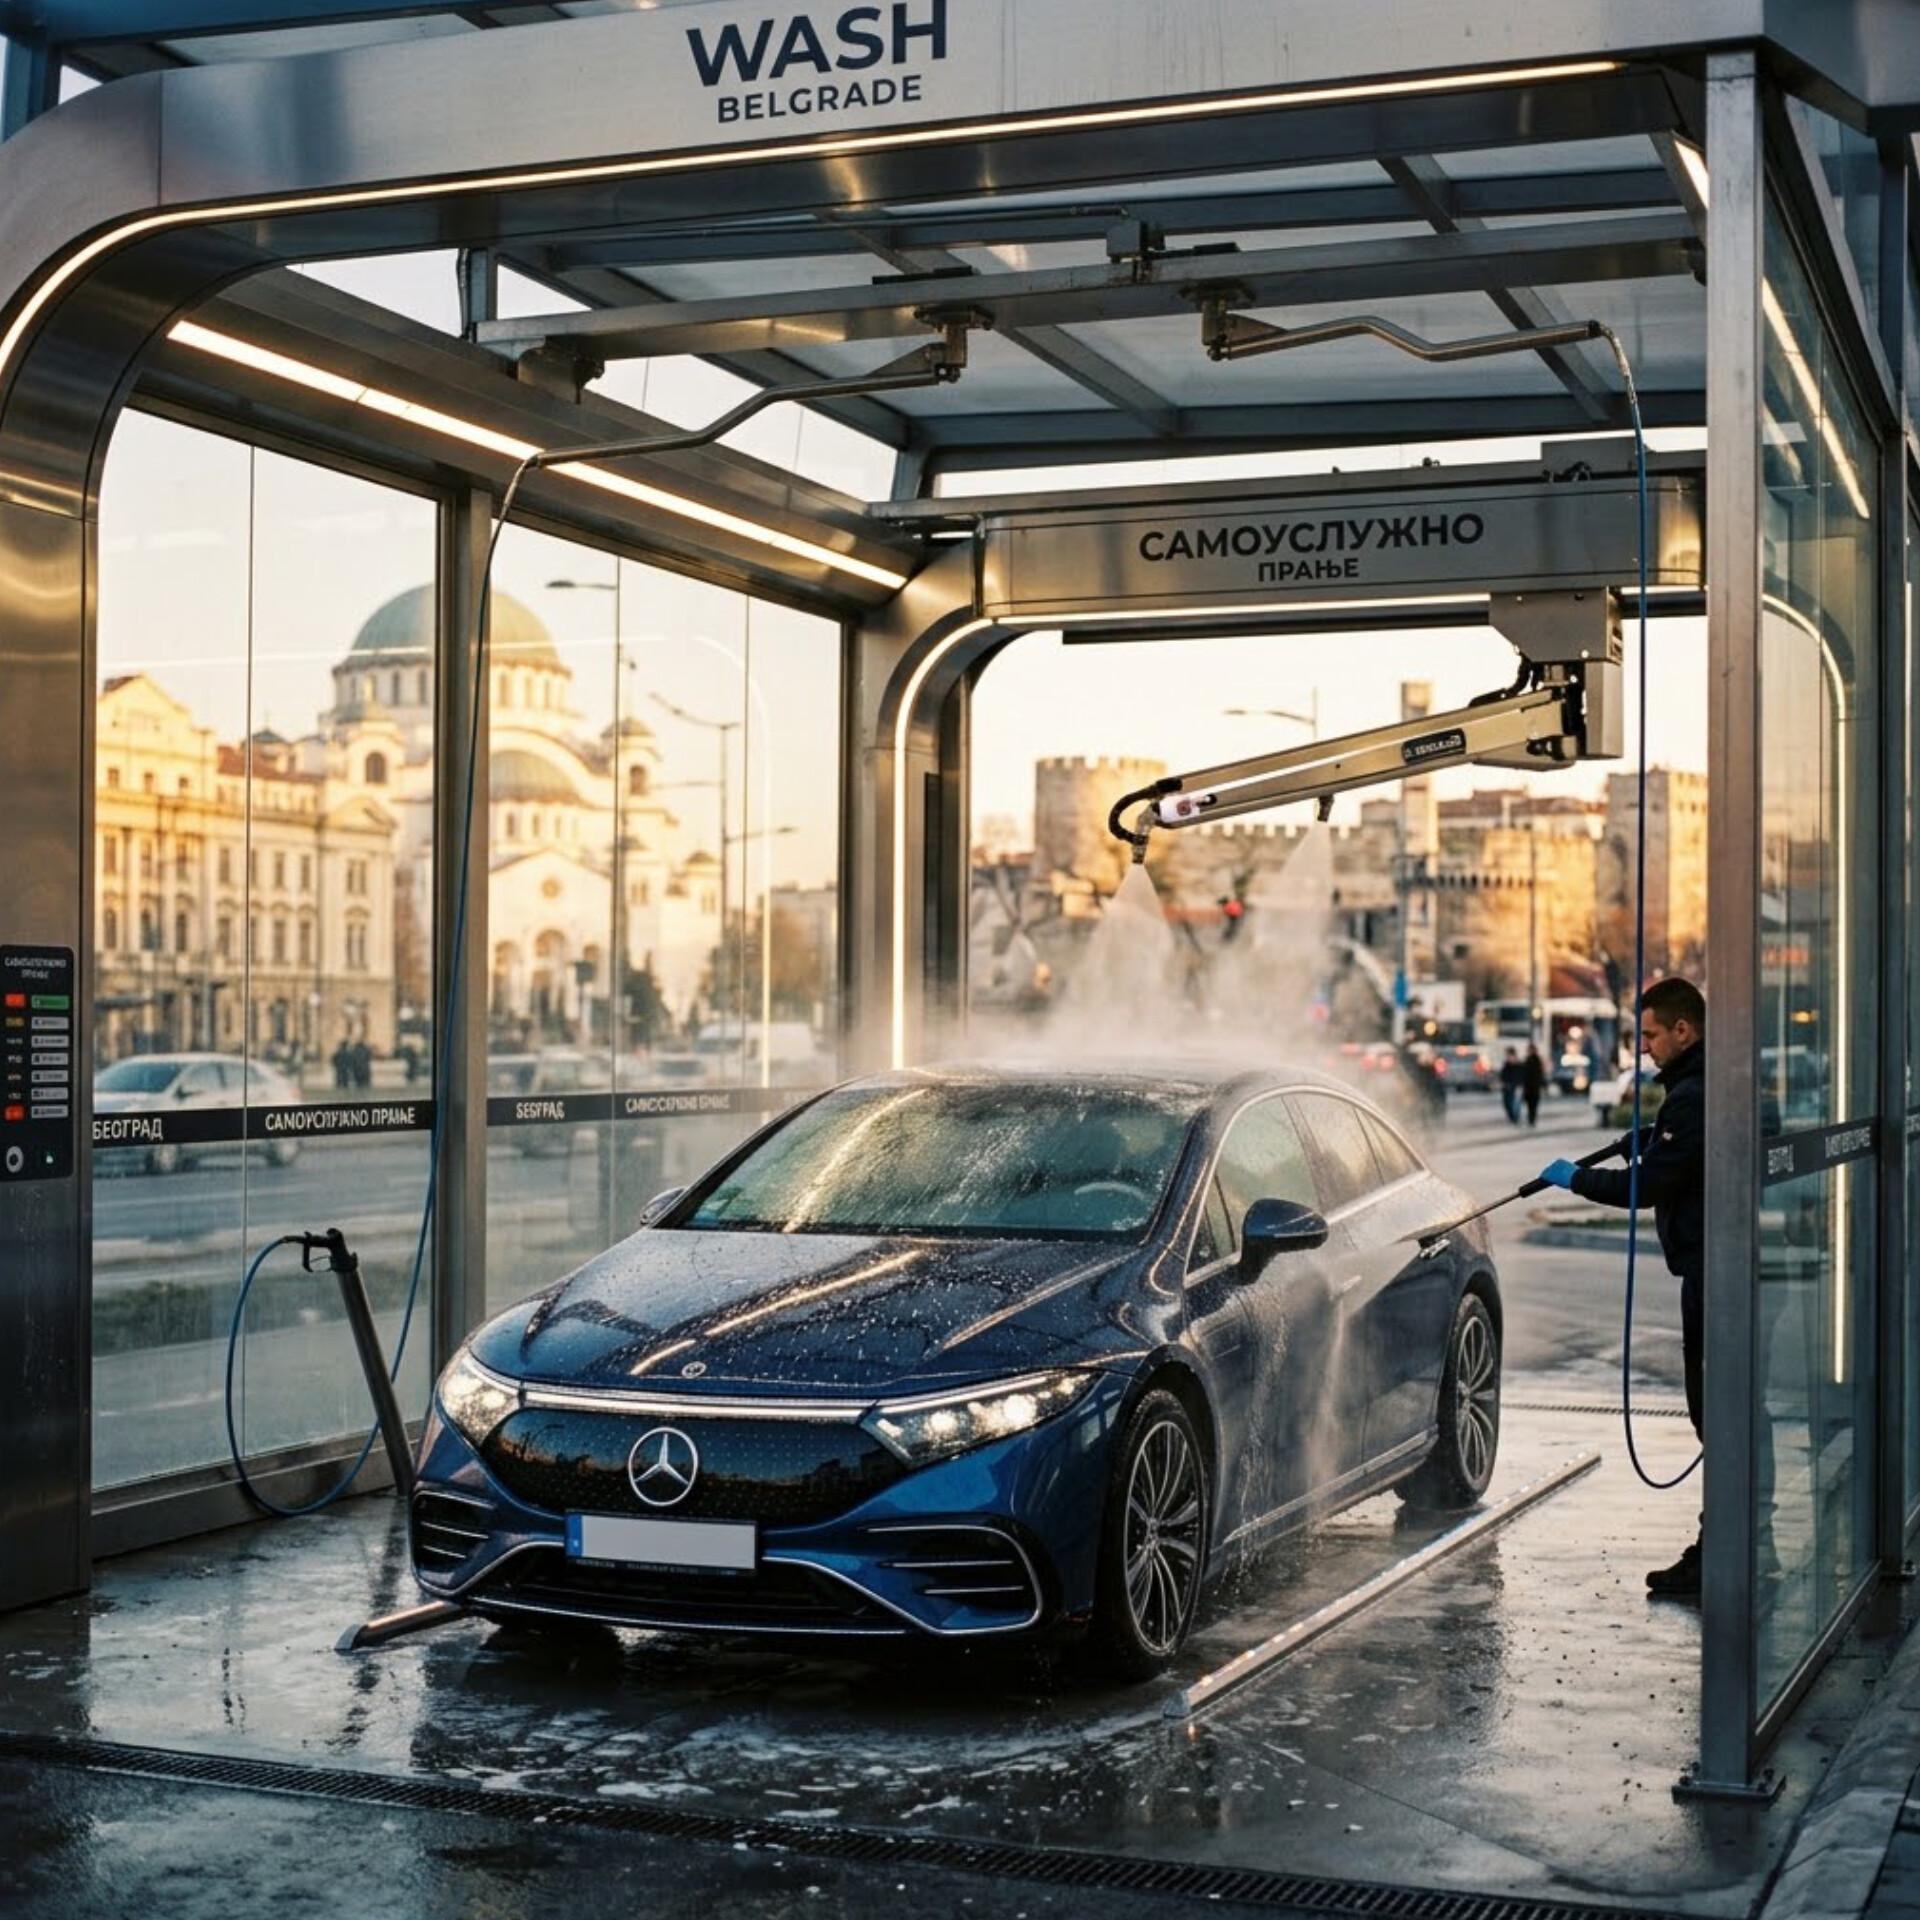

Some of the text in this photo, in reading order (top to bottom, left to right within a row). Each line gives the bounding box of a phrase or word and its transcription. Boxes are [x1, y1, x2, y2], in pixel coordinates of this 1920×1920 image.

[686, 0, 947, 87] WASH
[717, 75, 922, 124] BELGRADE
[1139, 513, 1485, 562] САМОУСЛУЖНО
[1258, 558, 1360, 582] ПРАЊЕ
